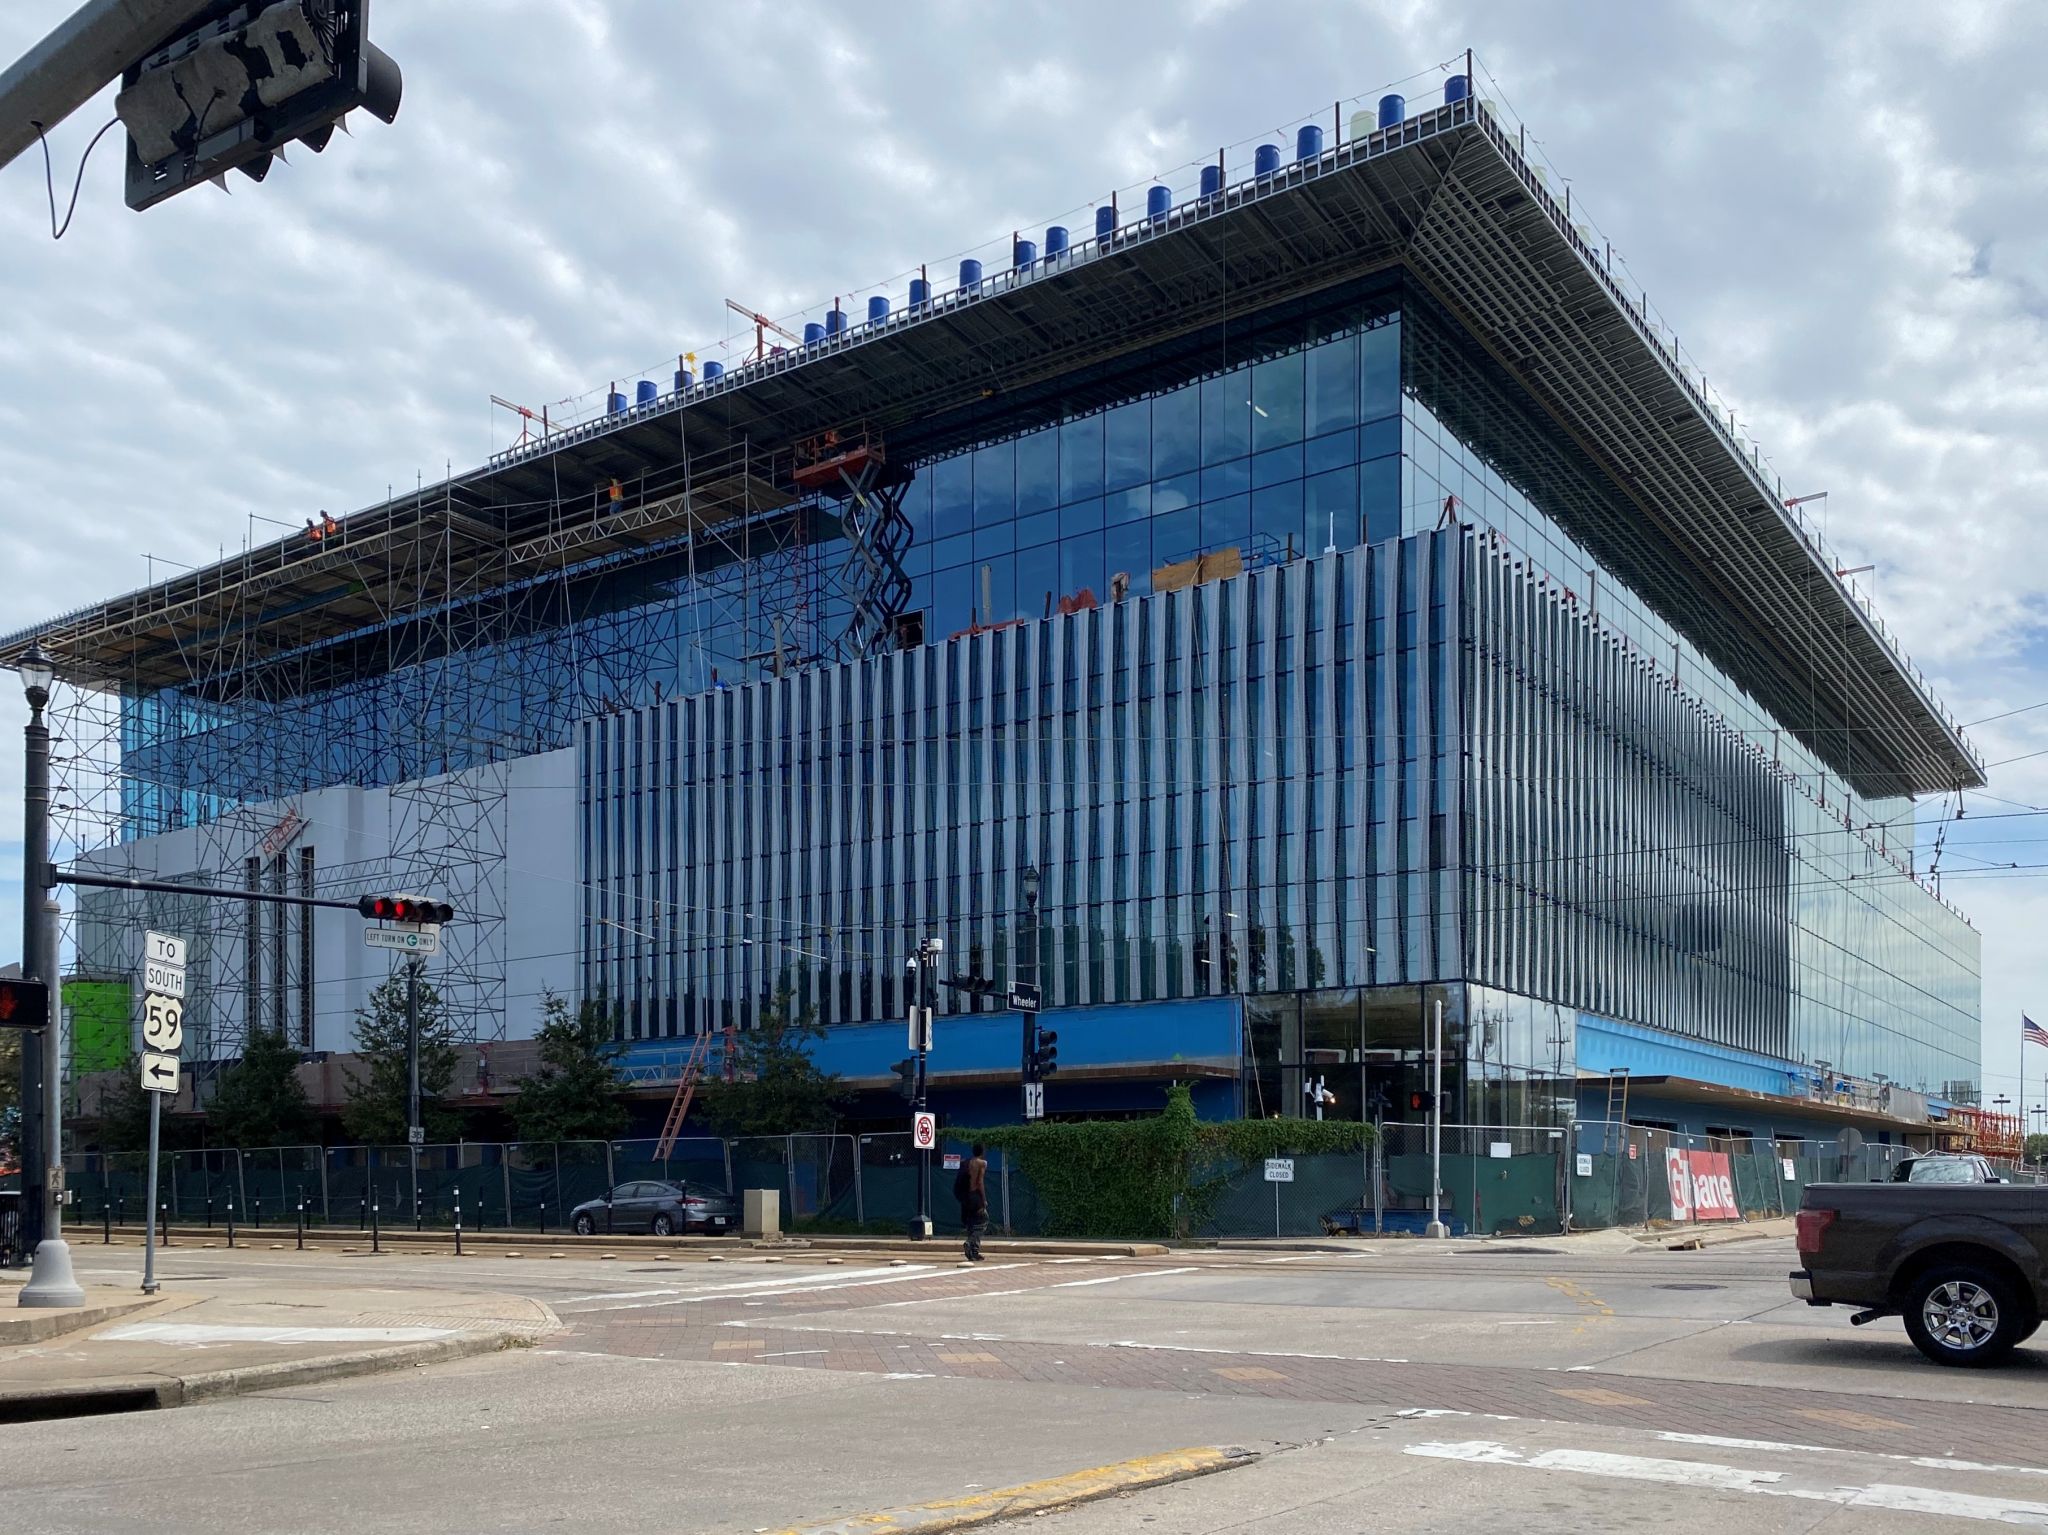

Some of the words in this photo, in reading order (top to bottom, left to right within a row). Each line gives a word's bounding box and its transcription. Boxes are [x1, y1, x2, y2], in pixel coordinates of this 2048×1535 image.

[367, 933, 380, 942] LEFT
[381, 934, 396, 943] TURN
[397, 935, 405, 944] ON
[419, 937, 433, 946] ONLY
[157, 940, 176, 958] TO
[148, 968, 183, 991] SOUTH
[1012, 994, 1037, 1008] Wheeler
[148, 1005, 179, 1038] 59
[1269, 1171, 1289, 1179] CLOSED
